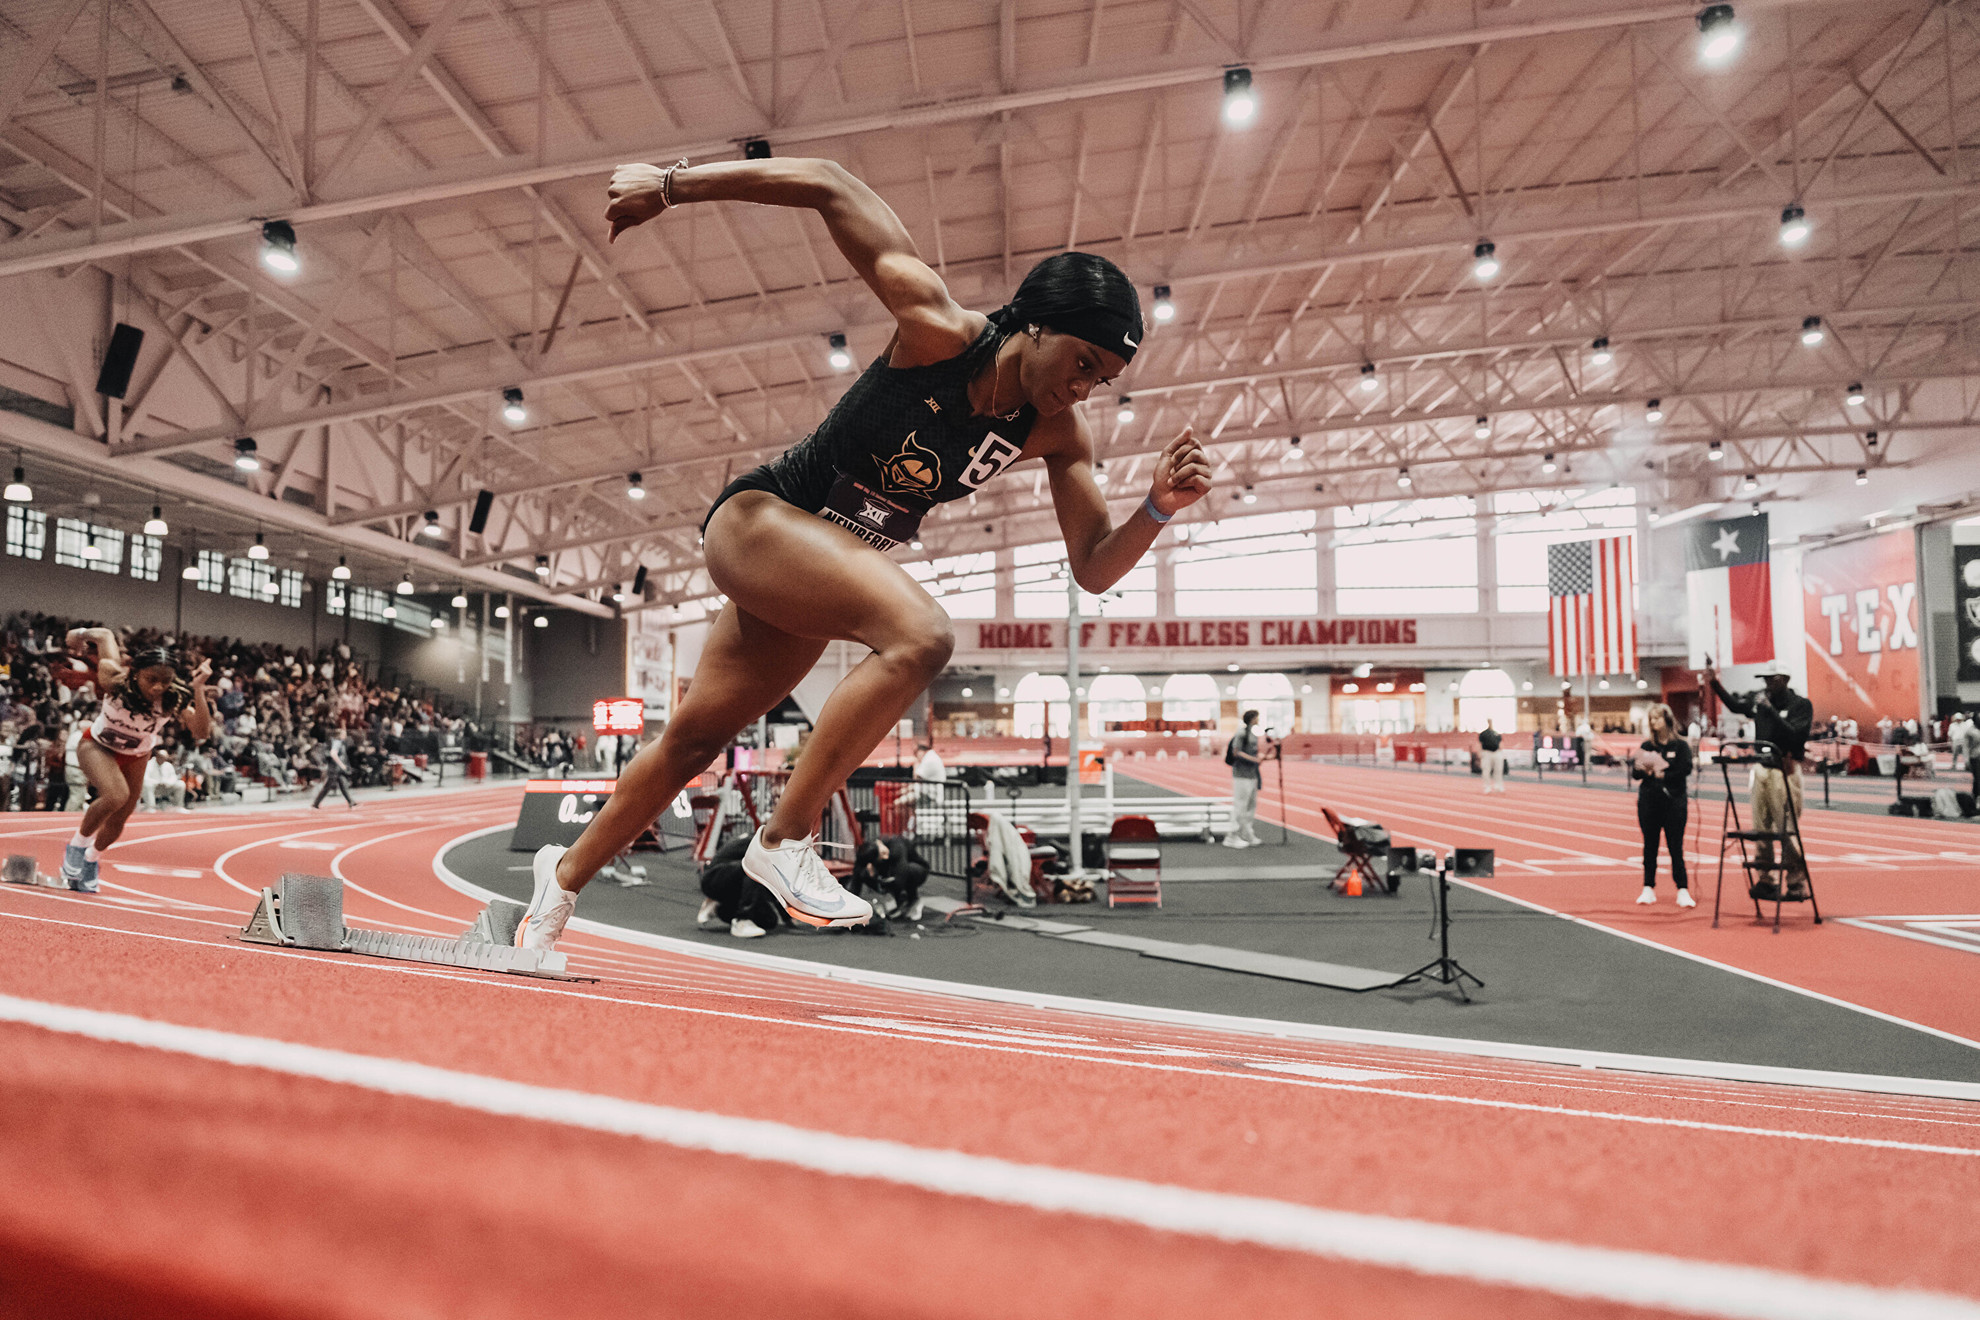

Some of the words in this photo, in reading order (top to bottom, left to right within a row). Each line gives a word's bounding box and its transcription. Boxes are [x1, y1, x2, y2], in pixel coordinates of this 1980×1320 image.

[968, 439, 1014, 486] 5
[822, 511, 899, 552] NEWBERRY
[858, 501, 891, 527] XII
[979, 623, 1053, 648] HOME
[1065, 622, 1097, 648] F
[1108, 621, 1249, 647] FEARLESS
[1261, 619, 1417, 646] CHAMPIONS
[1821, 582, 1917, 656] TEX
